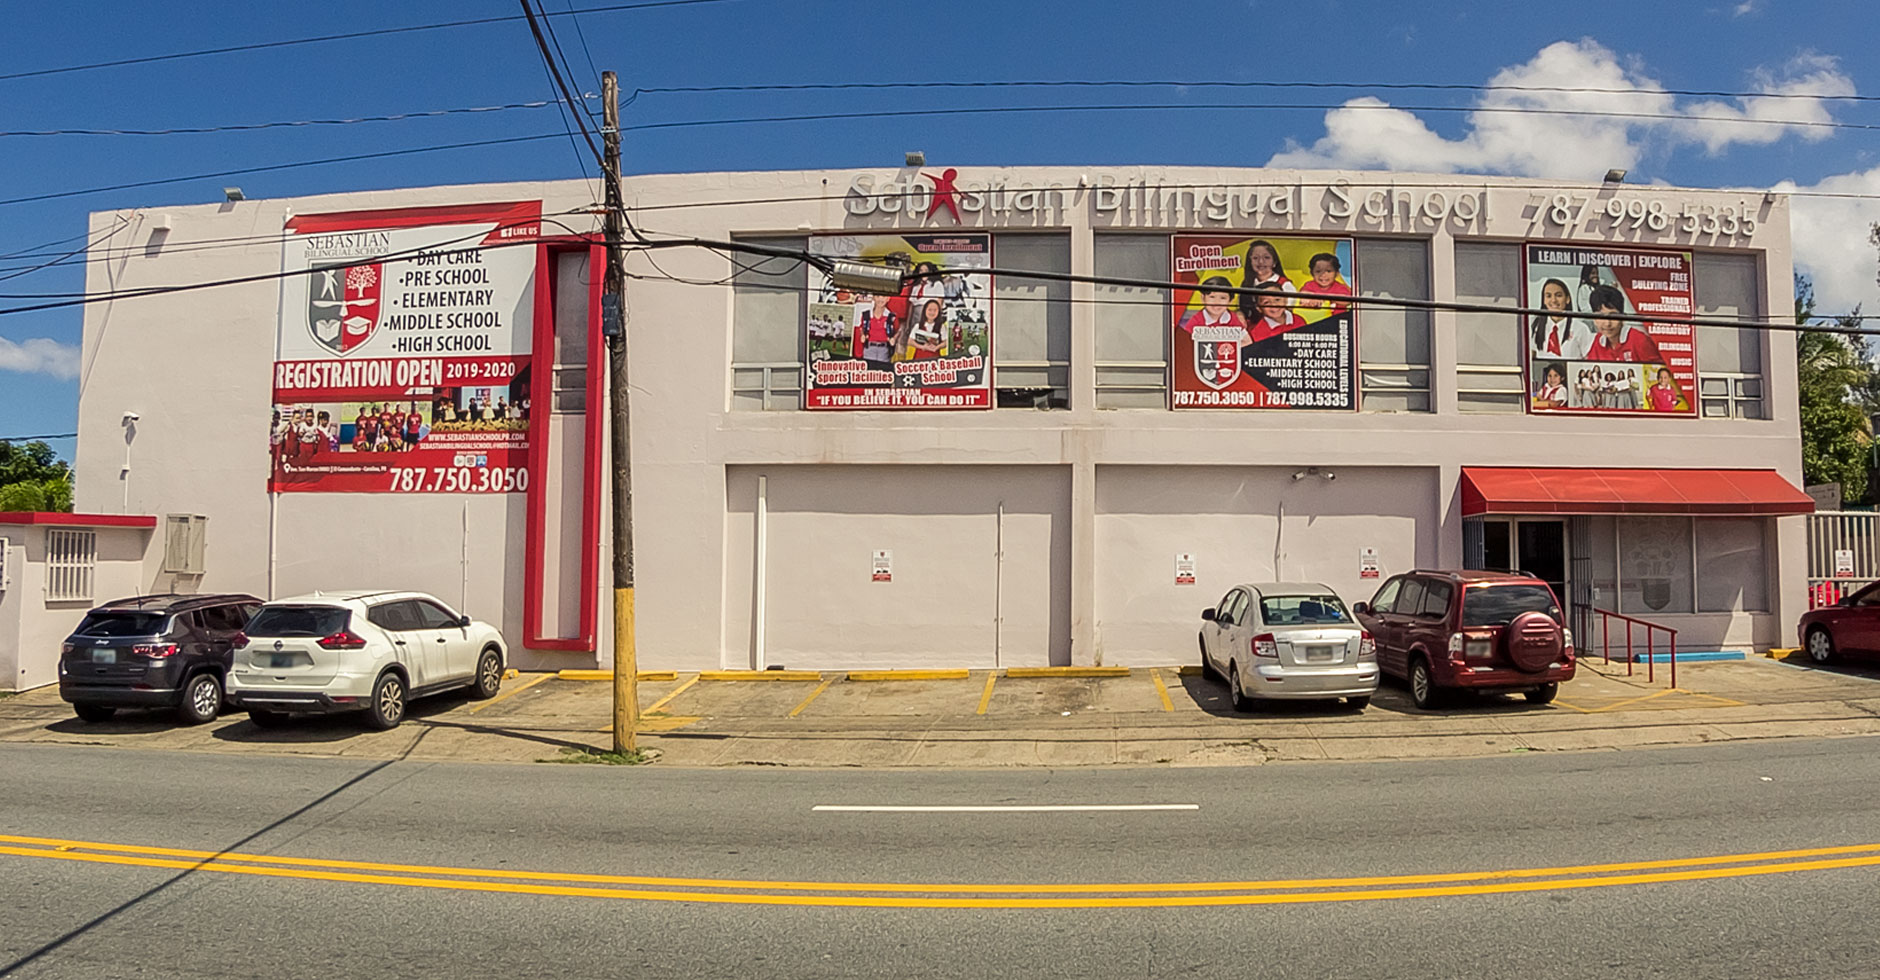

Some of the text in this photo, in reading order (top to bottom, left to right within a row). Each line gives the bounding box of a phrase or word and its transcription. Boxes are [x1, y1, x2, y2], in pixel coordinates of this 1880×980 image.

[850, 172, 1492, 221] Sebstian Bilingual School
[1529, 193, 1758, 236] 787-998-5335
[513, 227, 538, 236] LIKE US
[306, 232, 390, 250] SEBASTIAN
[304, 246, 389, 258] BILINGUAL SCHOOL
[417, 248, 482, 266] DAY CARE
[1191, 246, 1222, 258] Open
[1176, 256, 1240, 270] Enrollment
[1537, 251, 1683, 270] LEARN DISCOVER EXPLORE
[405, 268, 490, 287] PRE SCHOOL
[1670, 272, 1688, 282] FREE
[1669, 282, 1689, 292] ZONE
[402, 289, 494, 308] ELEMENTARY
[389, 311, 502, 331] MIDDLE SCHOOL
[398, 334, 492, 352] HIGH SCHOOL
[1297, 349, 1338, 359] DAY CARE
[817, 360, 867, 371] Innovative
[896, 356, 981, 375] Soccer & Baseball
[1248, 357, 1338, 369] ELEMENTARY SCHOOL
[275, 359, 516, 389] REGISTRATION OPEN 2019-2020
[817, 371, 894, 384] sports facilities
[922, 371, 956, 383] School
[1269, 368, 1338, 379] MIDDLE SCHOOL
[1280, 379, 1338, 390] HIGH SCHOOL
[832, 395, 852, 405] YOU
[853, 395, 891, 405] BELIEVE
[905, 395, 925, 405] YOU
[927, 395, 948, 405] CAN
[949, 395, 964, 405] DO
[1173, 391, 1255, 405] 787.750.3050
[1266, 392, 1349, 407] 787.998.5335
[389, 467, 529, 492] 787.750.3050
